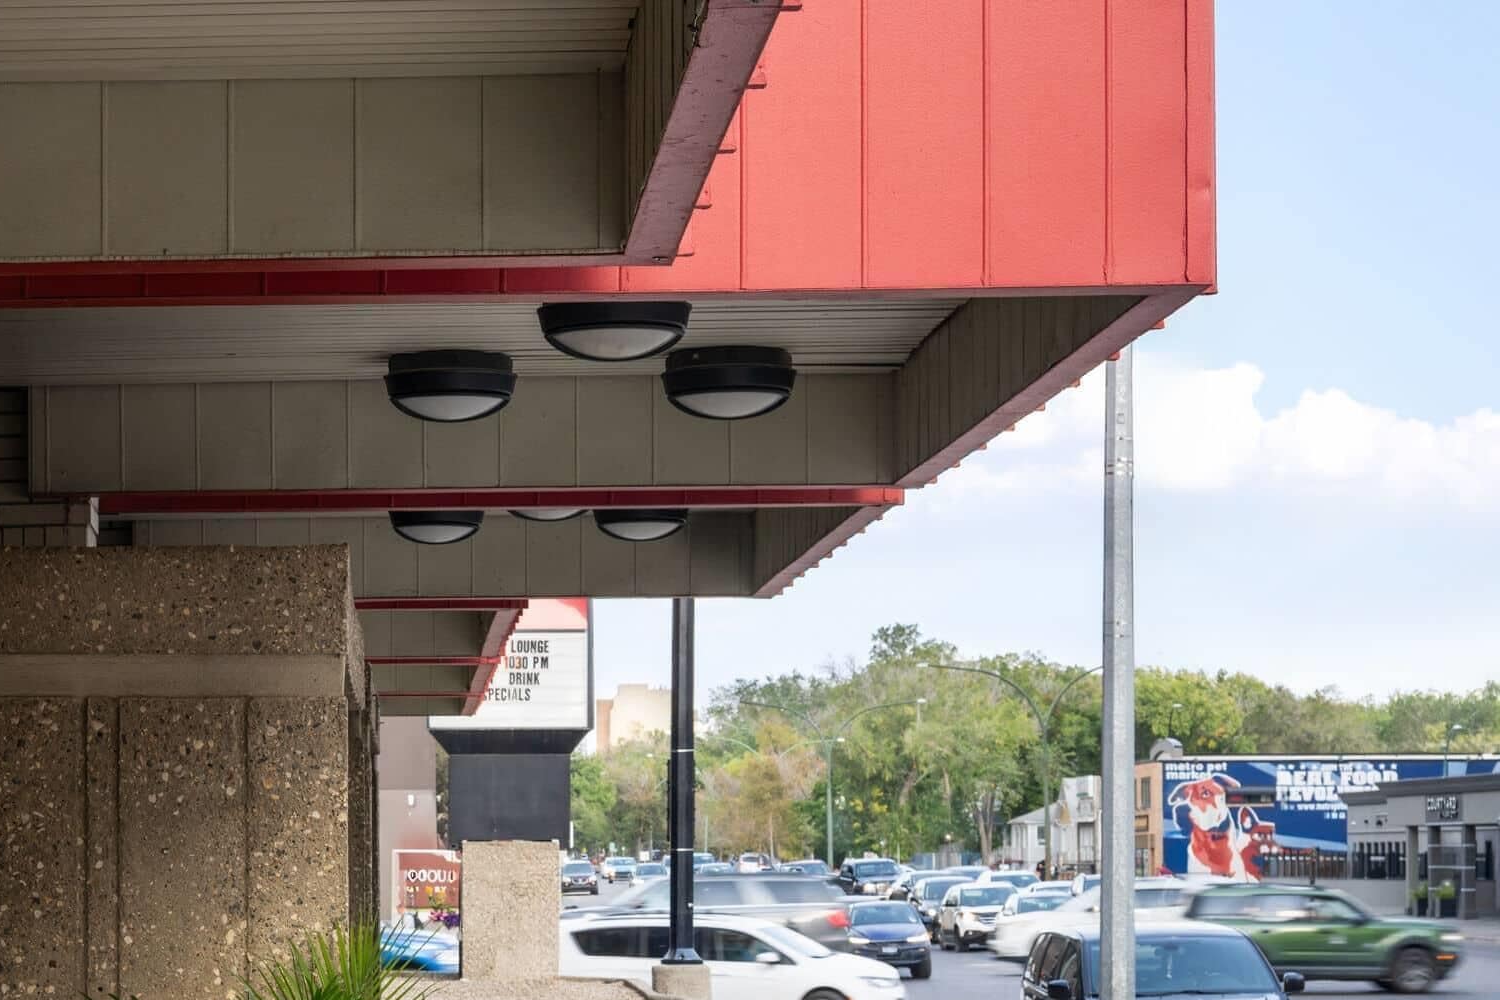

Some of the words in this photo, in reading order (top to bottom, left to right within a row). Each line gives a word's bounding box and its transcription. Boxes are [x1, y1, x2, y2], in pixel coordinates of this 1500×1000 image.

[511, 640, 549, 653] LOUNGE
[509, 672, 540, 685] DRINK
[1164, 762, 1204, 771] metro
